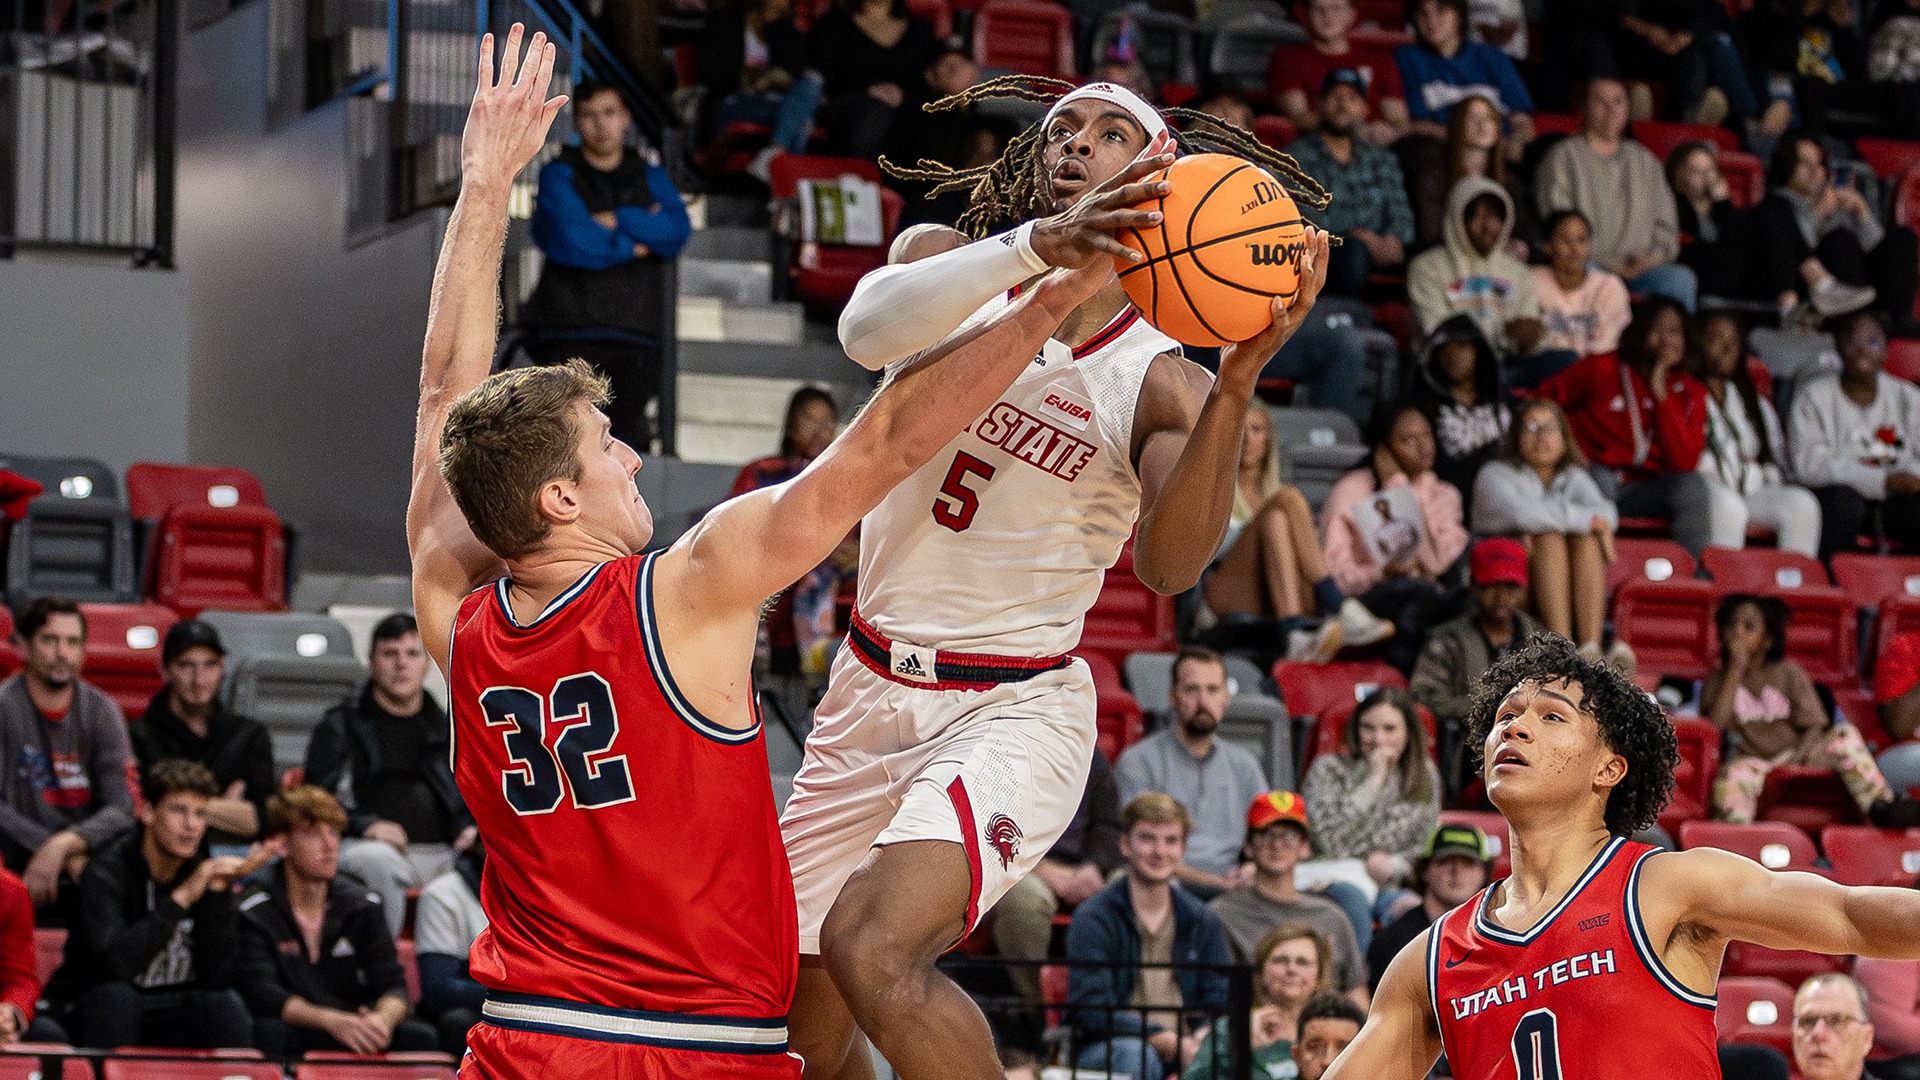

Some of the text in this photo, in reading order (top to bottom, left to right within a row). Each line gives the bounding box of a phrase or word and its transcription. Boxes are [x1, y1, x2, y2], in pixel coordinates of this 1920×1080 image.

[1253, 181, 1288, 206] VO
[1249, 242, 1305, 276] lson
[976, 401, 1099, 483] STATE
[931, 449, 997, 533] 5
[896, 664, 926, 678] adidas
[478, 670, 637, 817] 32
[1577, 912, 1611, 932] WAC
[1450, 948, 1616, 1020] UTAH TECH
[1511, 1007, 1564, 1080] 0
